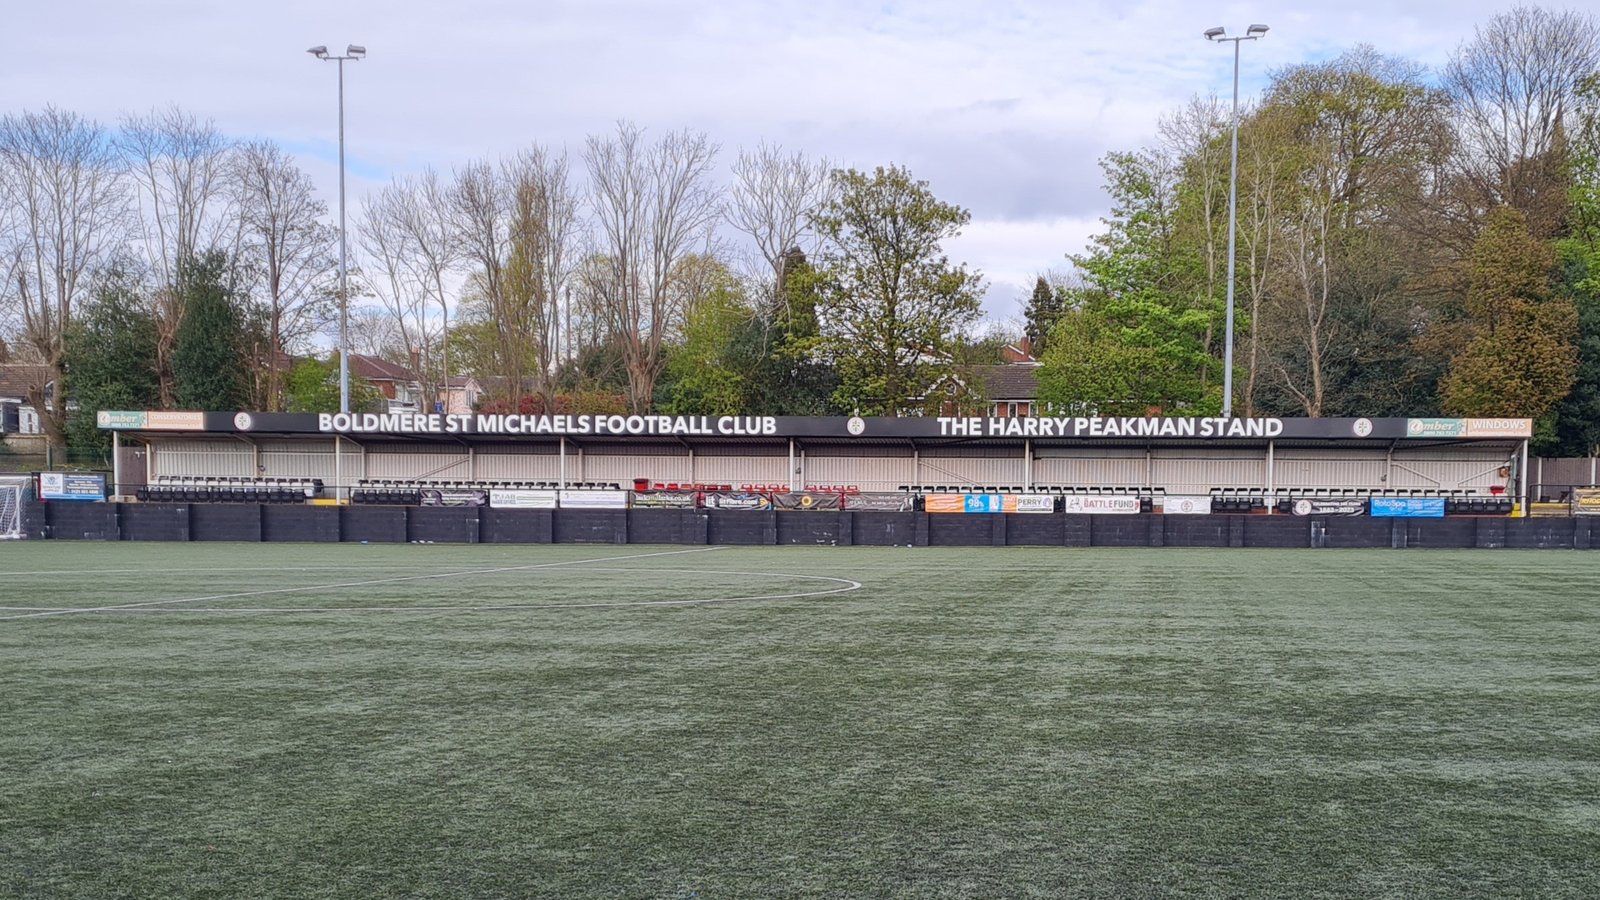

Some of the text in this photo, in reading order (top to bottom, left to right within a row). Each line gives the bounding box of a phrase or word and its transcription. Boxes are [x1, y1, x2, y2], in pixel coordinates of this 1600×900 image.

[318, 413, 777, 435] BOLDMERE ST MICHAELS FOOTBALL CLUB
[937, 416, 1284, 436] THE HARRY PEAKMAN STAND
[1472, 420, 1526, 429] WINDOWS
[1374, 499, 1407, 508] RotoSpa
